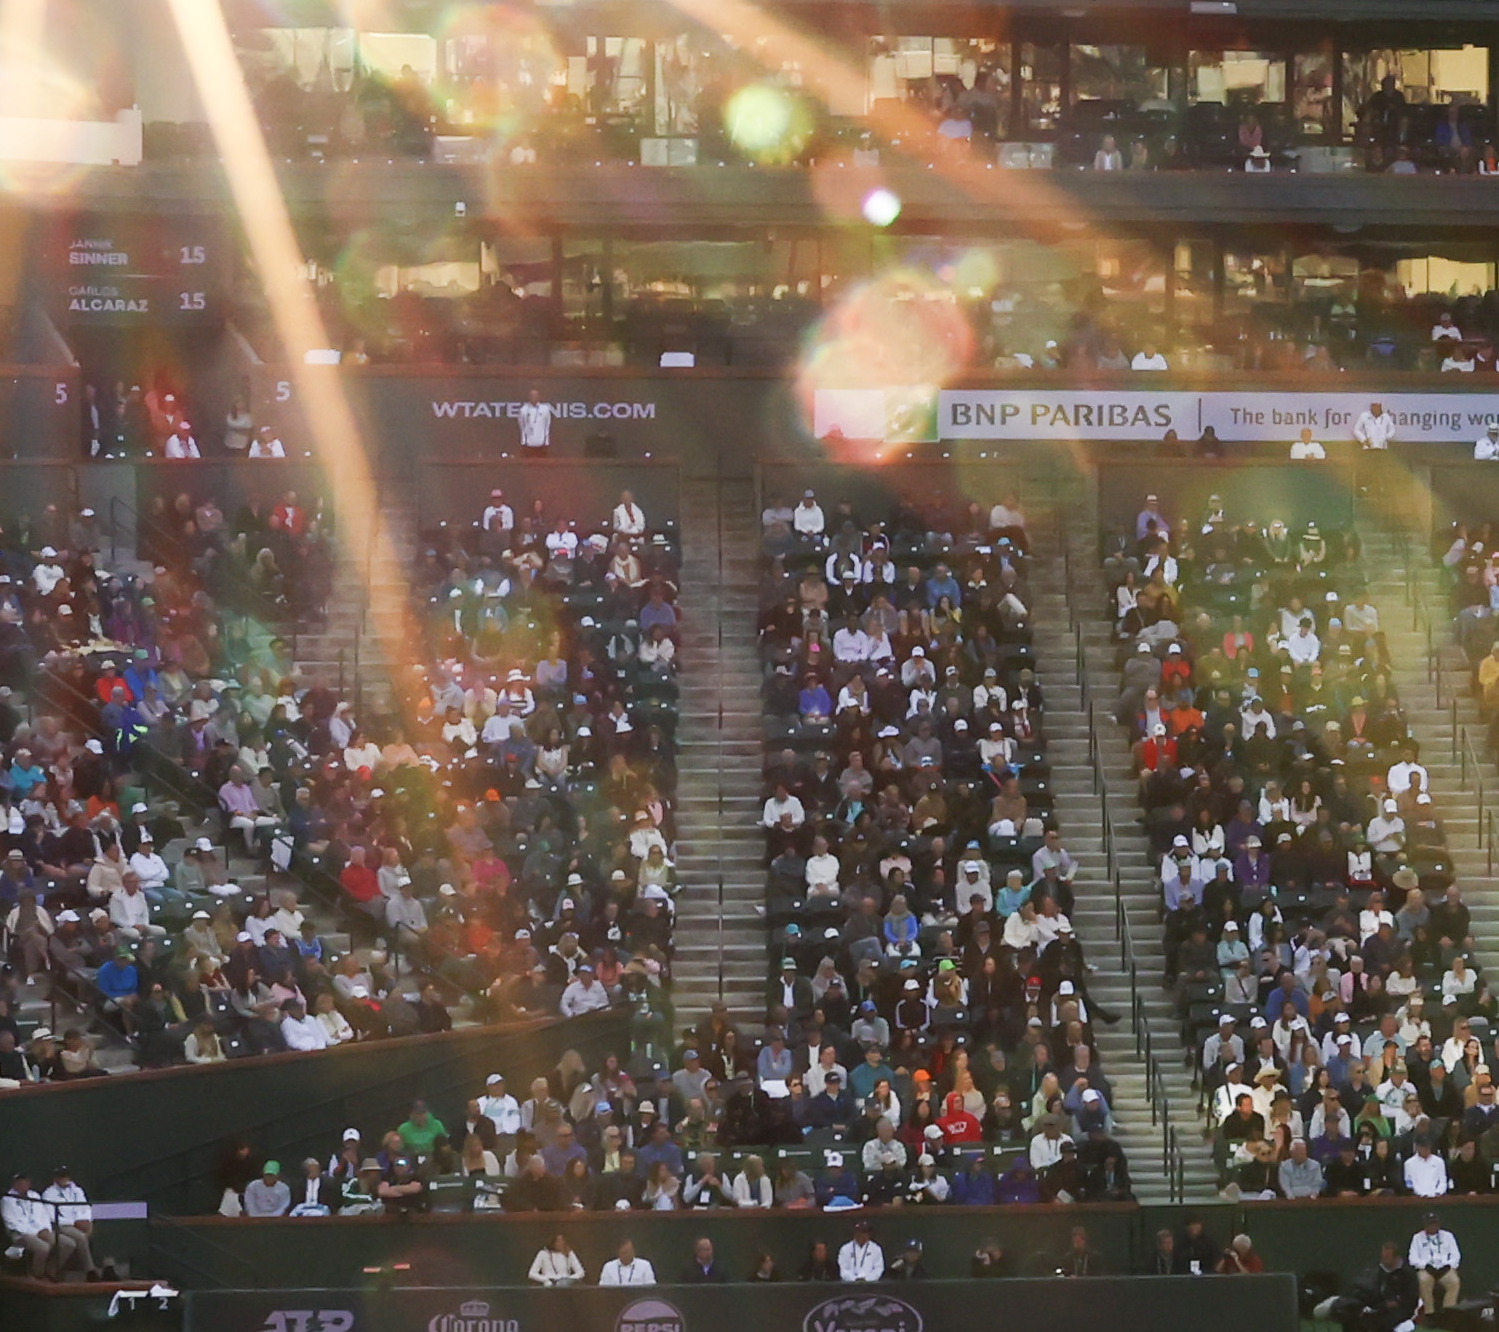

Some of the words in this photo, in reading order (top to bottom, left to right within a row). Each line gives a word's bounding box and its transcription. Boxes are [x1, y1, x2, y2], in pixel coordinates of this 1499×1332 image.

[180, 246, 205, 264] 15
[69, 299, 149, 313] ALCARAZ
[180, 292, 205, 310] 15
[55, 382, 68, 404] 5
[275, 381, 291, 403] 5
[432, 402, 656, 419] WTATENIS.COM
[951, 404, 1020, 426] BNP
[1030, 404, 1172, 427] PARIBAS
[1230, 408, 1264, 426] The
[1272, 407, 1318, 426] bank
[1324, 408, 1352, 429] for
[1388, 409, 1461, 431] hanging
[158, 1297, 169, 1310] 2
